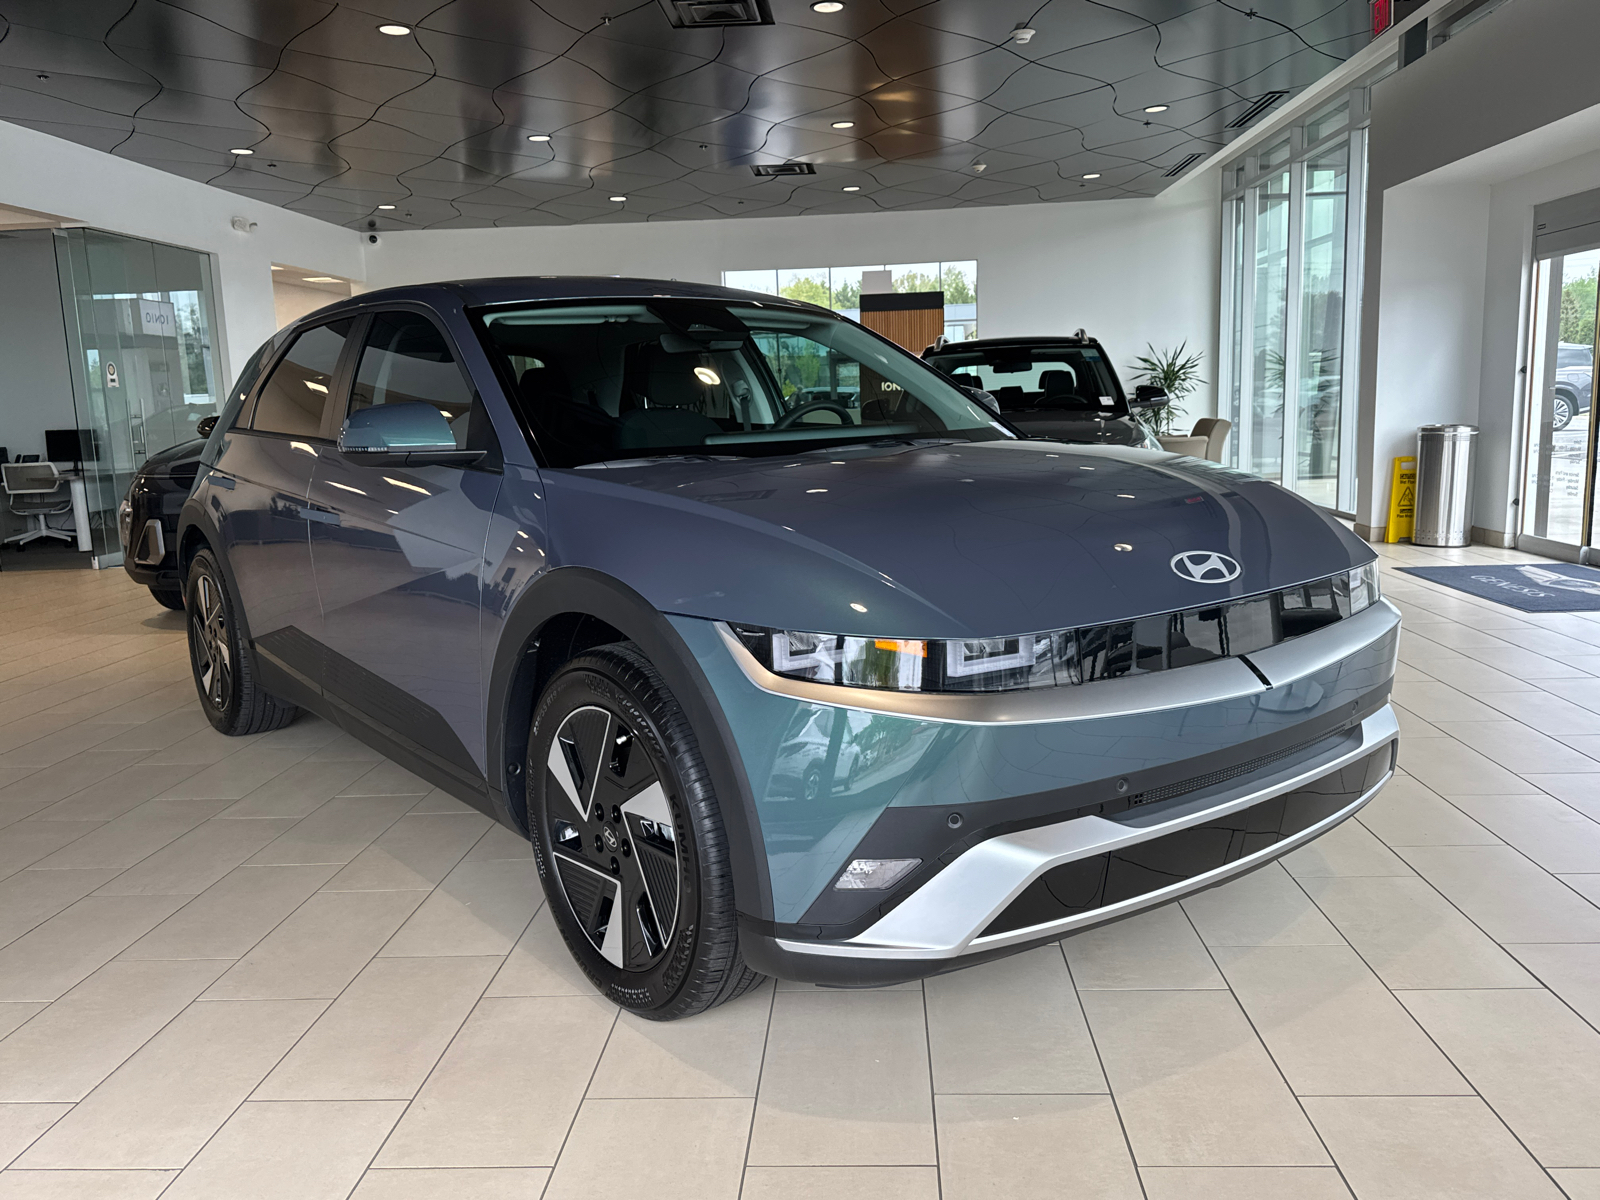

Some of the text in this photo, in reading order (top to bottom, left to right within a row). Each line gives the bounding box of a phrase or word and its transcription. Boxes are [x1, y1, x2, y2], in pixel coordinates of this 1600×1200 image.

[1374, 0, 1388, 35] EXIT
[881, 381, 903, 392] ION
[669, 794, 692, 894] KUMHO
